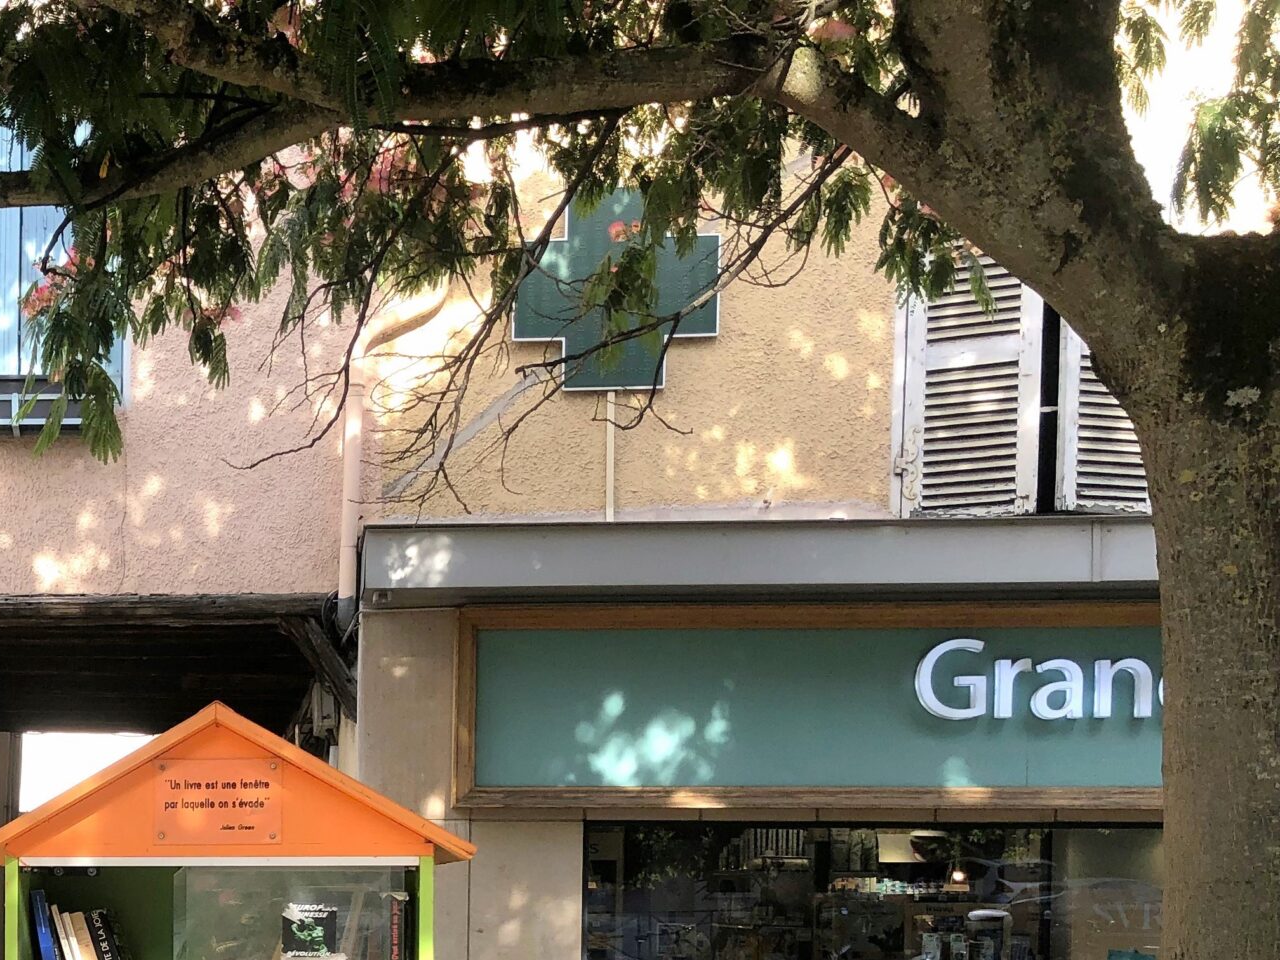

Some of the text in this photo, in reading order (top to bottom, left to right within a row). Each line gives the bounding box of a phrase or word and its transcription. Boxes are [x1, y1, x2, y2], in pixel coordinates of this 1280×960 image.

[915, 638, 1163, 720] Gran
[184, 779, 202, 790] livre
[205, 780, 218, 790] est
[221, 781, 237, 790] une
[240, 778, 270, 789] fenêtre
[164, 801, 178, 812] par
[181, 797, 215, 812] laquelle
[218, 800, 229, 809] on
[98, 928, 107, 941] LA
[100, 941, 109, 952] DE
